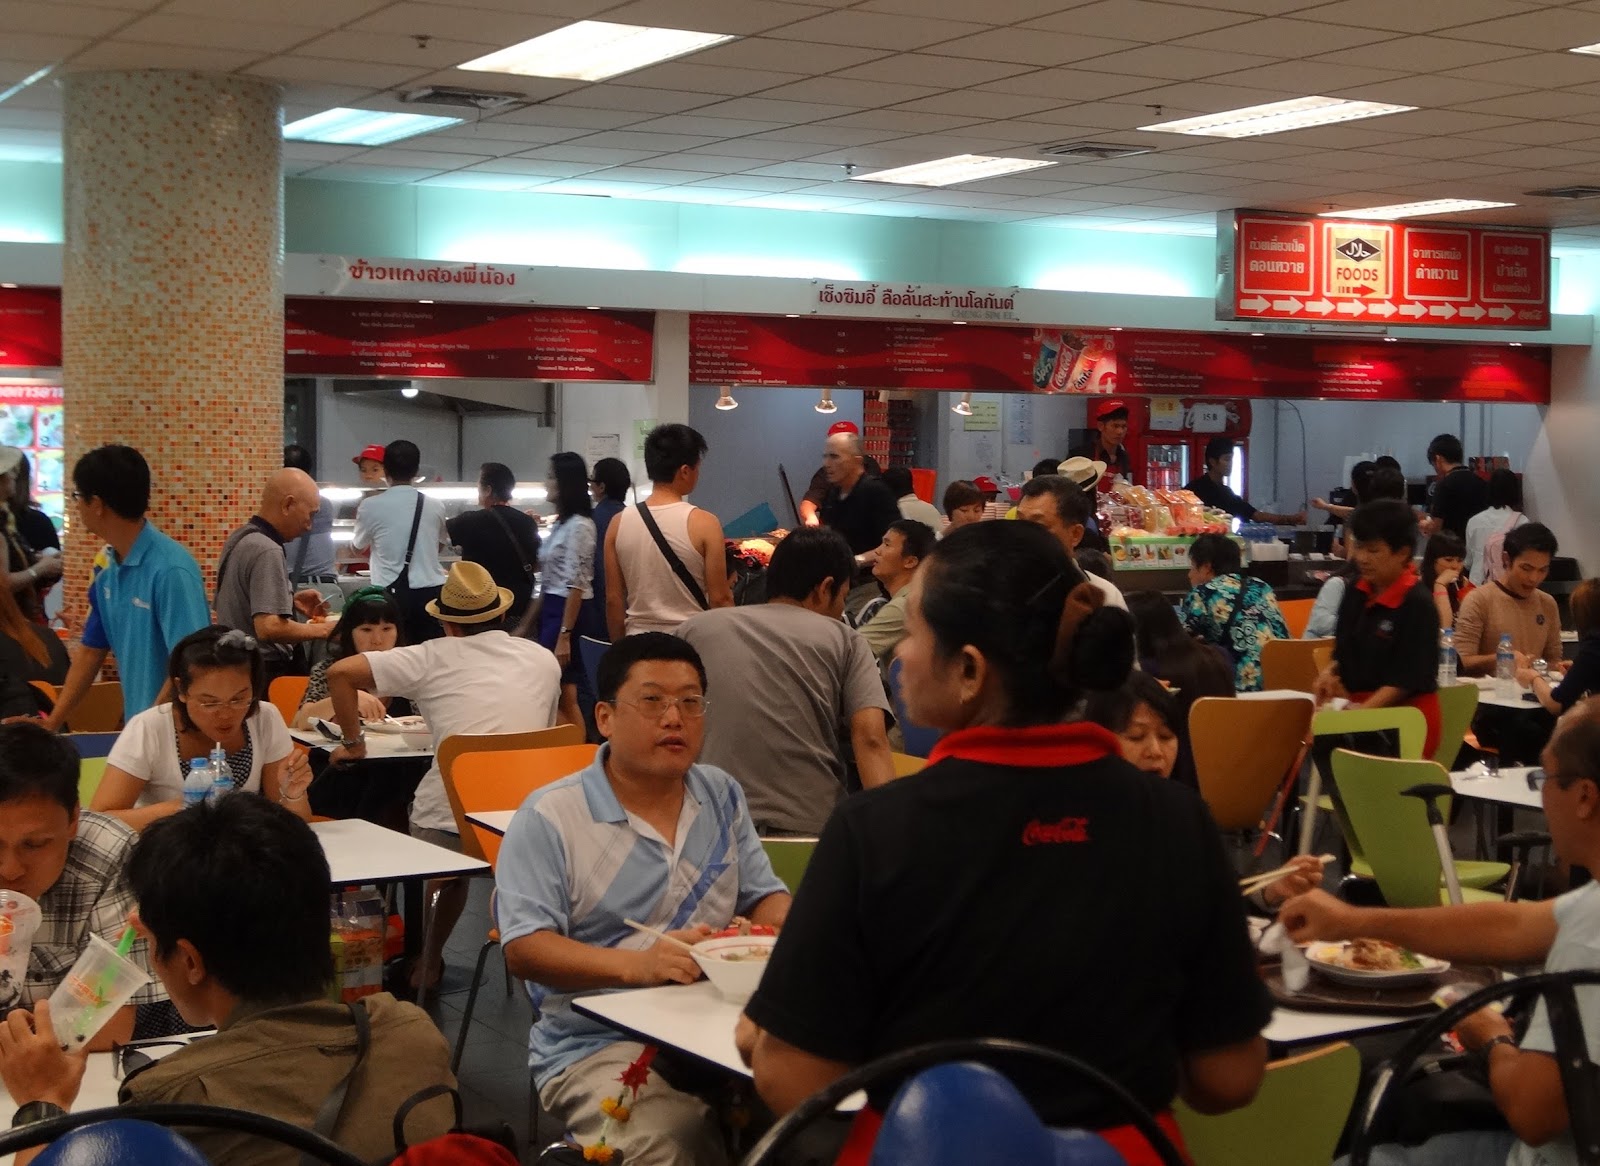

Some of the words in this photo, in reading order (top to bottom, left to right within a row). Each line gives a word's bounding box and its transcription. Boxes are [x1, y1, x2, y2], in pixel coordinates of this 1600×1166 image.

[349, 258, 515, 285] ข้าวแกงสองพี่น้อง
[1336, 267, 1378, 281] FOODS
